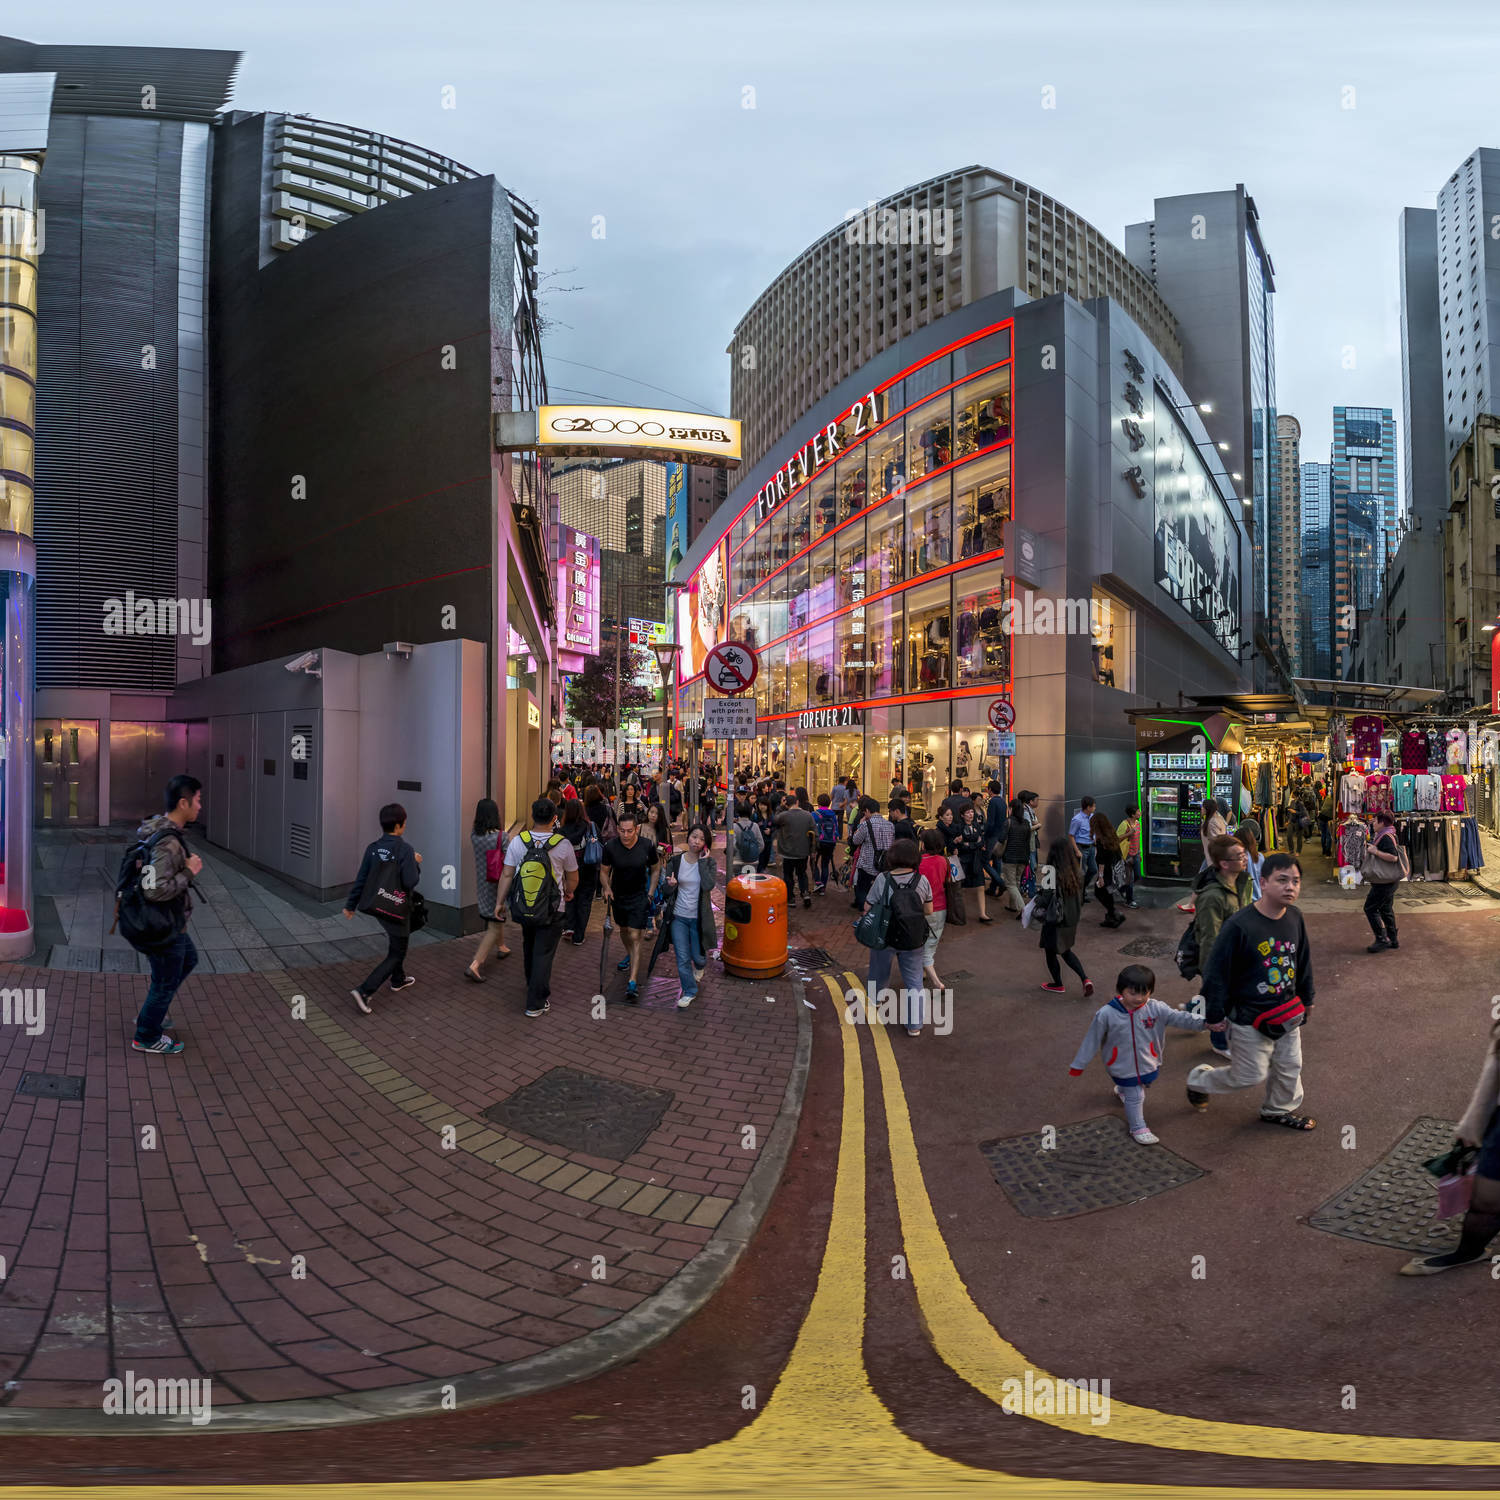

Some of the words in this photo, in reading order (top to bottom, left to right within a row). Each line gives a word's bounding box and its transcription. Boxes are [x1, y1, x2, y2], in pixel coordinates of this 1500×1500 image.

[551, 418, 665, 436] G2000
[670, 427, 731, 443] PLUS
[756, 421, 842, 520] FOREVER
[850, 390, 880, 438] 21
[718, 700, 743, 708] Except
[798, 708, 838, 729] FOREVER
[842, 706, 852, 726] 21
